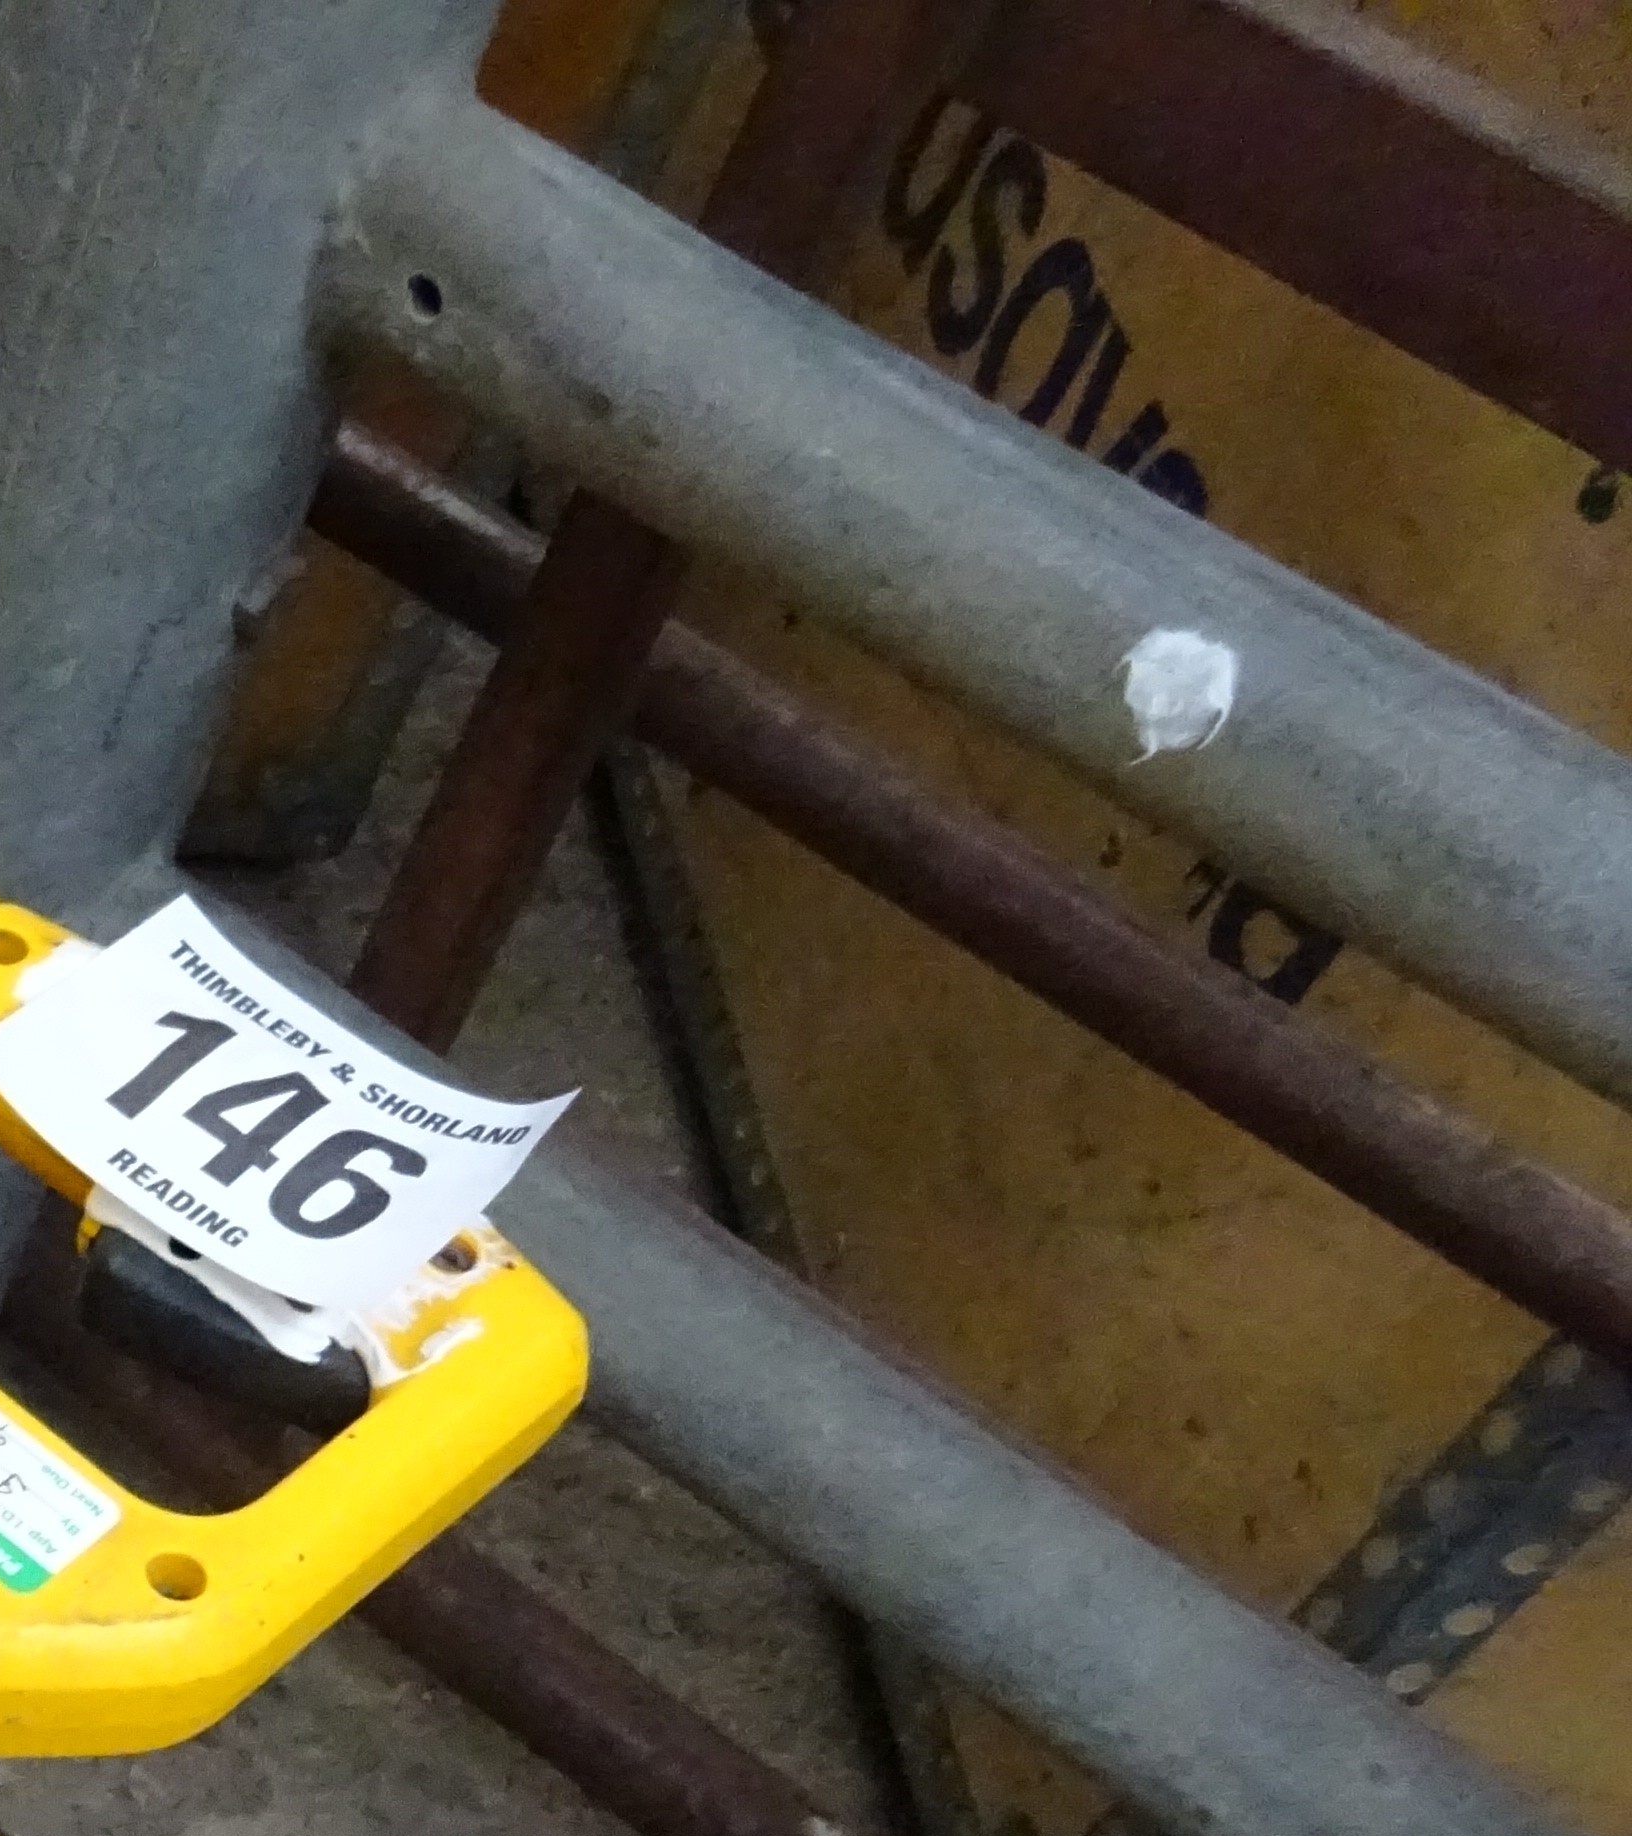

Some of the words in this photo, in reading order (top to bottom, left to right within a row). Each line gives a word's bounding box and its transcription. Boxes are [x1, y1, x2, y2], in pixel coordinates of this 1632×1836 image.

[170, 939, 332, 1060] THIMBLEBY
[330, 1061, 356, 1084] &
[359, 1083, 532, 1147] SHORLAND
[104, 1010, 428, 1240] 146
[107, 1147, 250, 1248] READING
[40, 1464, 71, 1490] Due
[70, 1487, 104, 1518] Next
[60, 1518, 81, 1537] By
